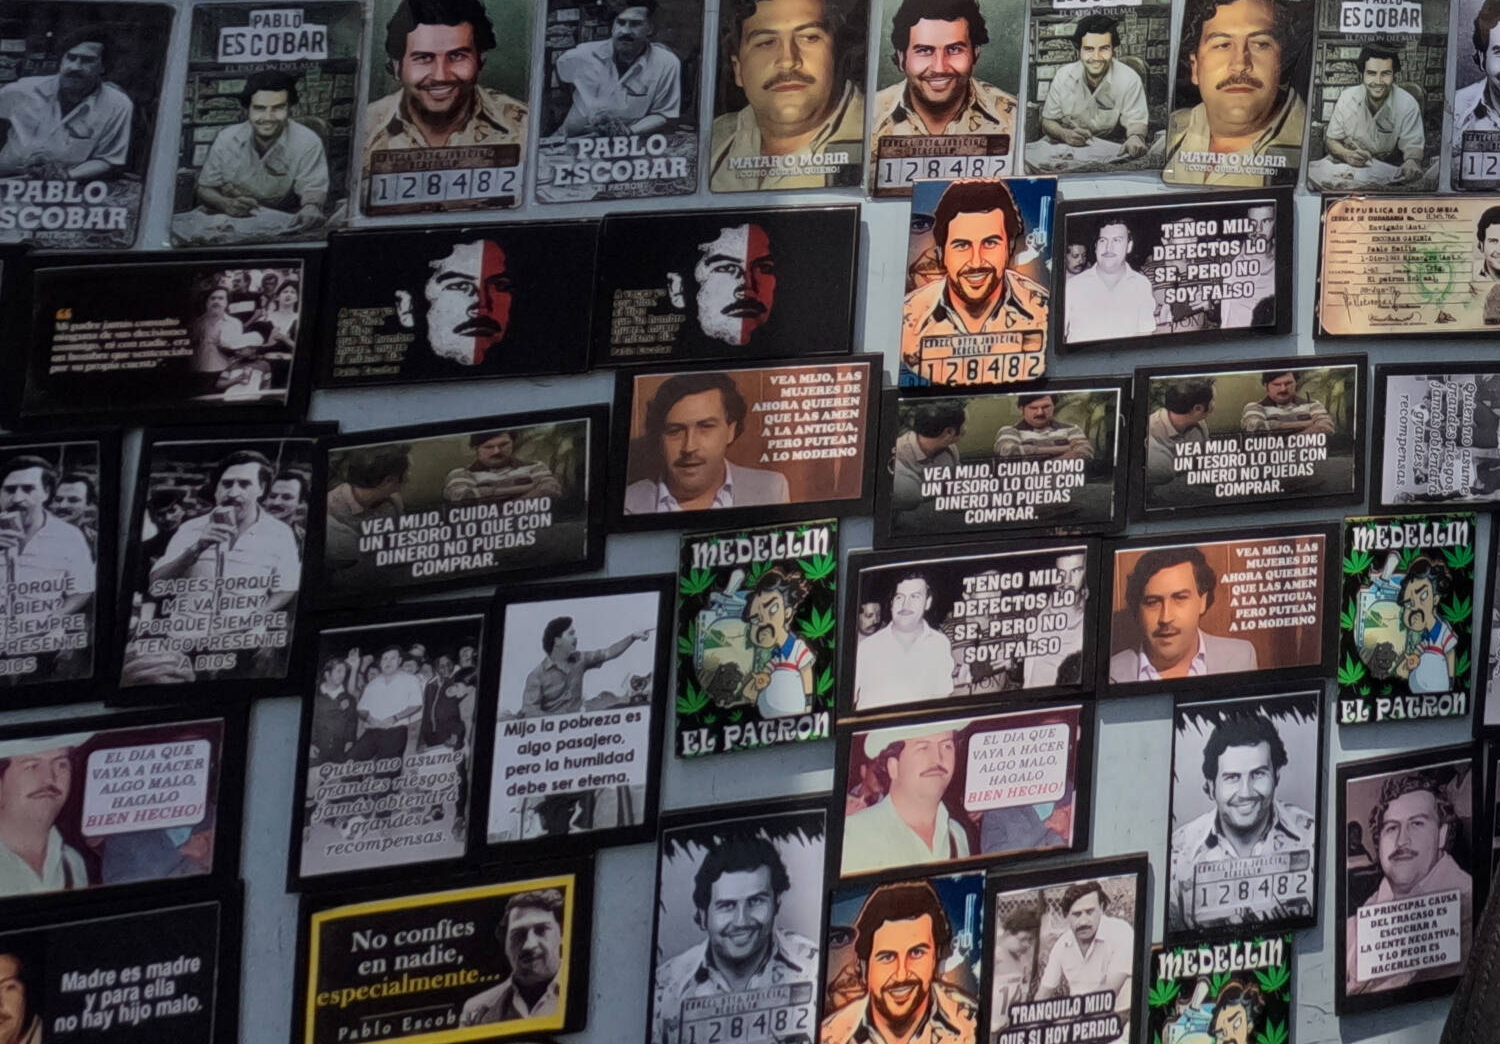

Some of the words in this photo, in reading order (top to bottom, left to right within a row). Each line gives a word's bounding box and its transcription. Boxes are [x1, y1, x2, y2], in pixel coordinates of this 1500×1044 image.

[253, 14, 302, 29] PABLO
[1343, 7, 1420, 28] ESCOBAR
[222, 30, 325, 56] ESCOBAR
[577, 134, 667, 159] PABLO
[1180, 151, 1225, 164] MATAR
[1229, 154, 1241, 164] O
[1242, 155, 1287, 167] MORIR
[554, 157, 688, 186] ESCOBAR
[3, 180, 108, 204] PABLO
[0, 206, 128, 229] SCOBAR
[1161, 221, 1217, 238] TENGO
[1223, 218, 1253, 234] MIL
[1153, 240, 1240, 261] DEFECTOS
[1246, 239, 1266, 254] LO
[1187, 262, 1231, 279] PERO
[1237, 260, 1259, 275] NO
[1166, 286, 1197, 303] SOY
[1202, 282, 1254, 300] FALSO
[770, 375, 797, 385] VEA
[800, 373, 834, 383] MIJO,
[837, 371, 862, 381] LAS
[780, 386, 840, 397] MUJERES
[843, 384, 861, 393] DE
[752, 401, 799, 412] AHORA
[802, 397, 860, 410] QUIEREN
[764, 413, 791, 424] QUE
[794, 412, 819, 422] LAS
[821, 409, 859, 420] AMEN
[762, 428, 771, 436] A
[774, 426, 791, 436] LA
[794, 422, 858, 434] ANTIGUA,
[768, 438, 801, 449] PERO
[805, 434, 858, 447] PUTEAN
[1176, 442, 1201, 456] VEA
[1206, 439, 1240, 454] MIJO,
[1245, 436, 1284, 451] CUIDA
[1288, 433, 1326, 448] COMO
[760, 453, 769, 462] A
[773, 452, 789, 461] LO
[792, 447, 857, 460] MODERNO
[1174, 457, 1193, 471] UN
[1196, 454, 1246, 469] TESORO
[1251, 453, 1266, 465] LO
[1270, 450, 1296, 464] QUE
[1300, 448, 1327, 462] CON
[1187, 469, 1236, 484] DINERO
[1241, 467, 1259, 480] NO
[1264, 462, 1314, 478] PUEDAS
[1215, 480, 1285, 497] COMPRAR.
[1353, 521, 1469, 553] MEDELLIN
[691, 526, 829, 570] MEDELLIN
[153, 579, 208, 595] SABES
[163, 599, 186, 613] ME
[220, 595, 266, 610] BIEN?
[139, 618, 206, 634] PORQUE
[212, 612, 286, 630] SIEMPRE
[139, 638, 195, 653] TENGO
[199, 632, 286, 651] PRESENTE
[180, 658, 190, 670] A
[196, 656, 235, 669] DIOS
[1341, 698, 1369, 724] EL
[1376, 691, 1466, 721] PATRON
[504, 722, 536, 738] Mijo
[541, 719, 554, 731] la
[559, 713, 620, 733] pobreza
[626, 712, 641, 722] es
[681, 728, 716, 755] EL
[723, 710, 830, 751] PATRON
[983, 735, 998, 745] EL
[1003, 732, 1024, 743] DIA
[1029, 728, 1056, 741] QUE
[517, 741, 551, 755] algo
[973, 748, 1003, 760] VAYA
[1008, 747, 1016, 756] A
[1020, 741, 1064, 755] HACER
[505, 763, 540, 779] pero
[545, 759, 559, 771] la
[564, 749, 634, 769] humildad
[979, 760, 1016, 773] ALGO
[1019, 755, 1057, 768] MALO,
[506, 781, 547, 796] debe
[552, 778, 573, 790] ser
[578, 773, 630, 787] eterna.
[968, 789, 1003, 803] BIEN
[1374, 899, 1425, 915] PRINCIPAL
[1428, 893, 1457, 905] CAUSA
[1371, 919, 1388, 928] DEL
[1391, 910, 1433, 924] FRACASO
[1436, 907, 1447, 915] ES
[1380, 922, 1429, 938] ESCUCHAR
[1432, 920, 1437, 928] A
[351, 930, 387, 952] No
[1360, 945, 1372, 953] LA
[1375, 938, 1406, 950] GENTE
[1386, 951, 1398, 960] LO
[1401, 946, 1426, 957] PEOR
[1429, 943, 1440, 951] ES
[358, 959, 386, 975] en
[394, 944, 464, 970] nadie,
[1371, 958, 1420, 974] HACERLES
[1423, 953, 1446, 964] CASO
[61, 969, 117, 992] Madre
[120, 966, 141, 983] es
[146, 955, 200, 979] madre
[86, 993, 96, 1011] y
[101, 986, 140, 1008] para
[144, 978, 175, 998] ella
[54, 1015, 77, 1032] no
[82, 1009, 114, 1030] hay
[118, 1004, 151, 1025] hijo
[156, 994, 202, 1017] malo.
[1011, 998, 1081, 1024] TRANQUILO
[338, 1021, 391, 1041] Pablo
[1045, 1025, 1069, 1044] HOY
[1072, 1017, 1120, 1041] PERDIO.
